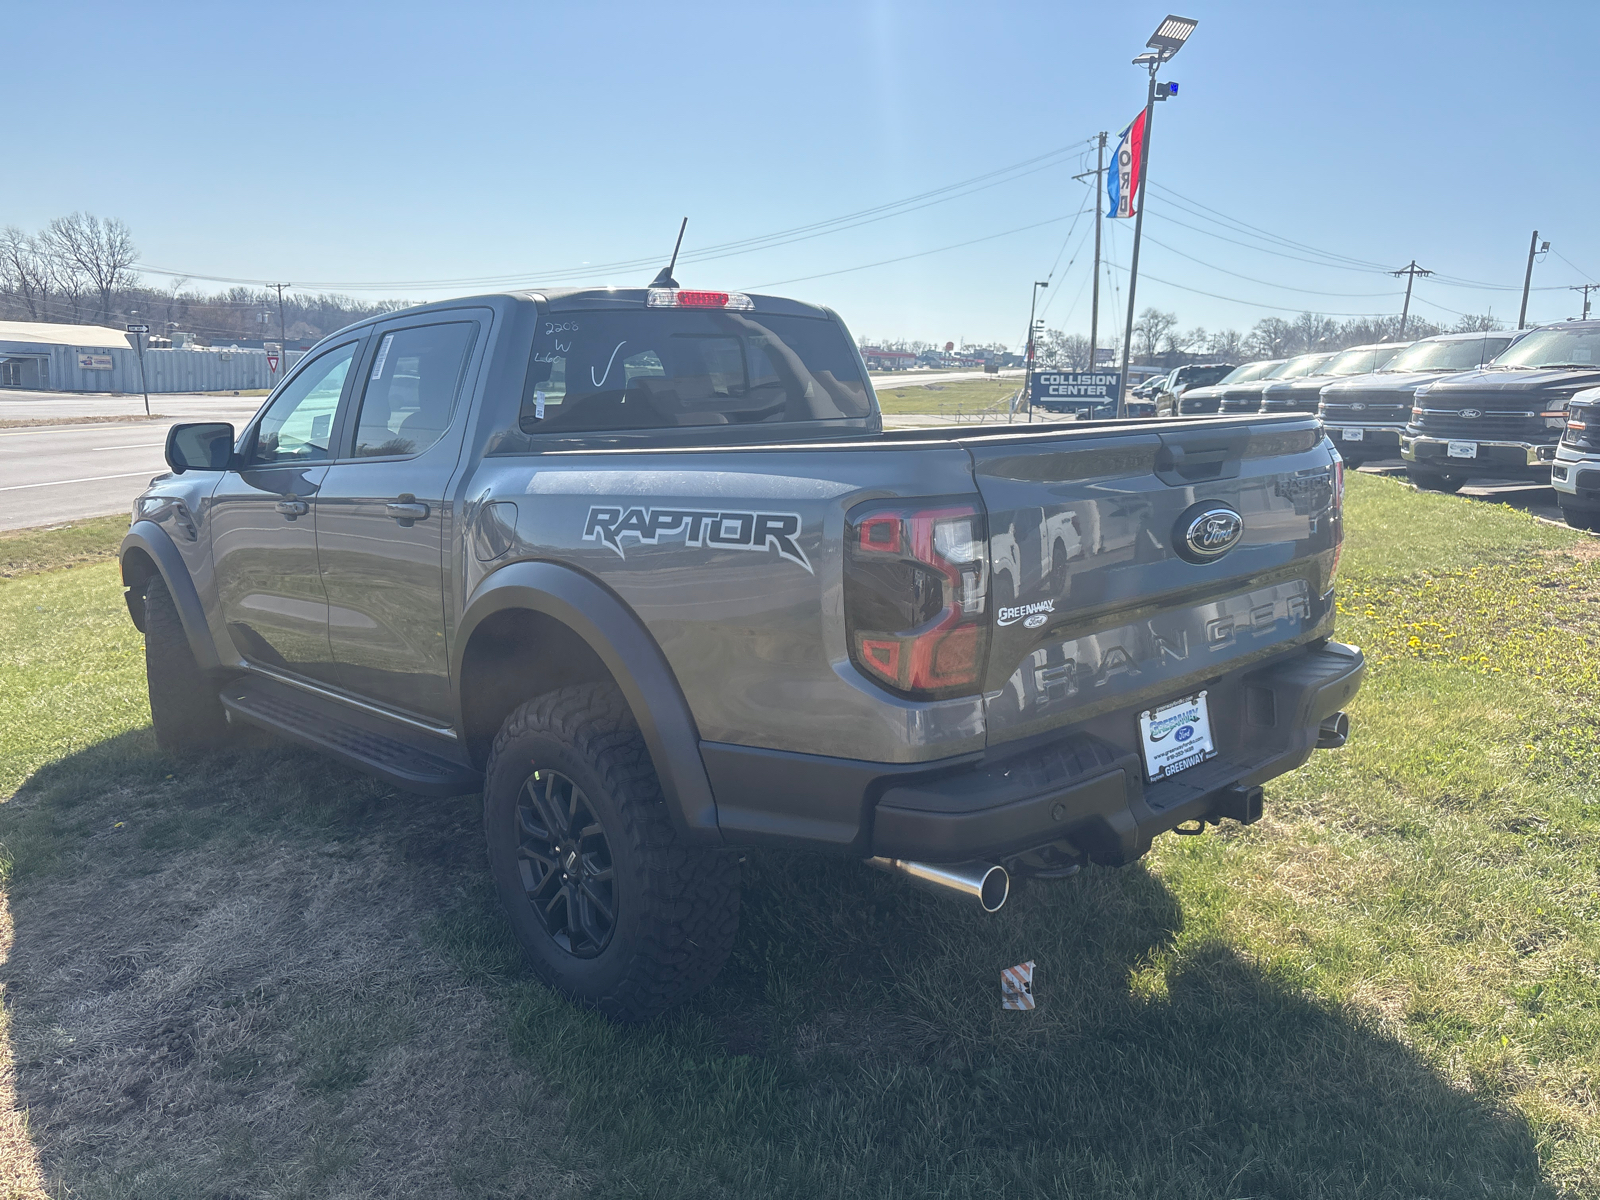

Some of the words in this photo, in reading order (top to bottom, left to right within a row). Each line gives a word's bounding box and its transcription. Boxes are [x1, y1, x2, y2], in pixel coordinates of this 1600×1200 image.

[545, 320, 579, 335] 2208
[555, 339, 572, 353] W
[1040, 375, 1117, 385] COLLISION
[1049, 385, 1107, 395] CENTER
[1203, 516, 1235, 546] Ford
[582, 505, 815, 576] RAPTOR
[998, 599, 1055, 621] GREENWAY
[1027, 615, 1045, 626] Ford
[1034, 596, 1311, 703] RANGER
[1150, 708, 1199, 736] GREENWAY
[1177, 727, 1191, 741] Ford
[1165, 752, 1204, 776] GREENWAY
